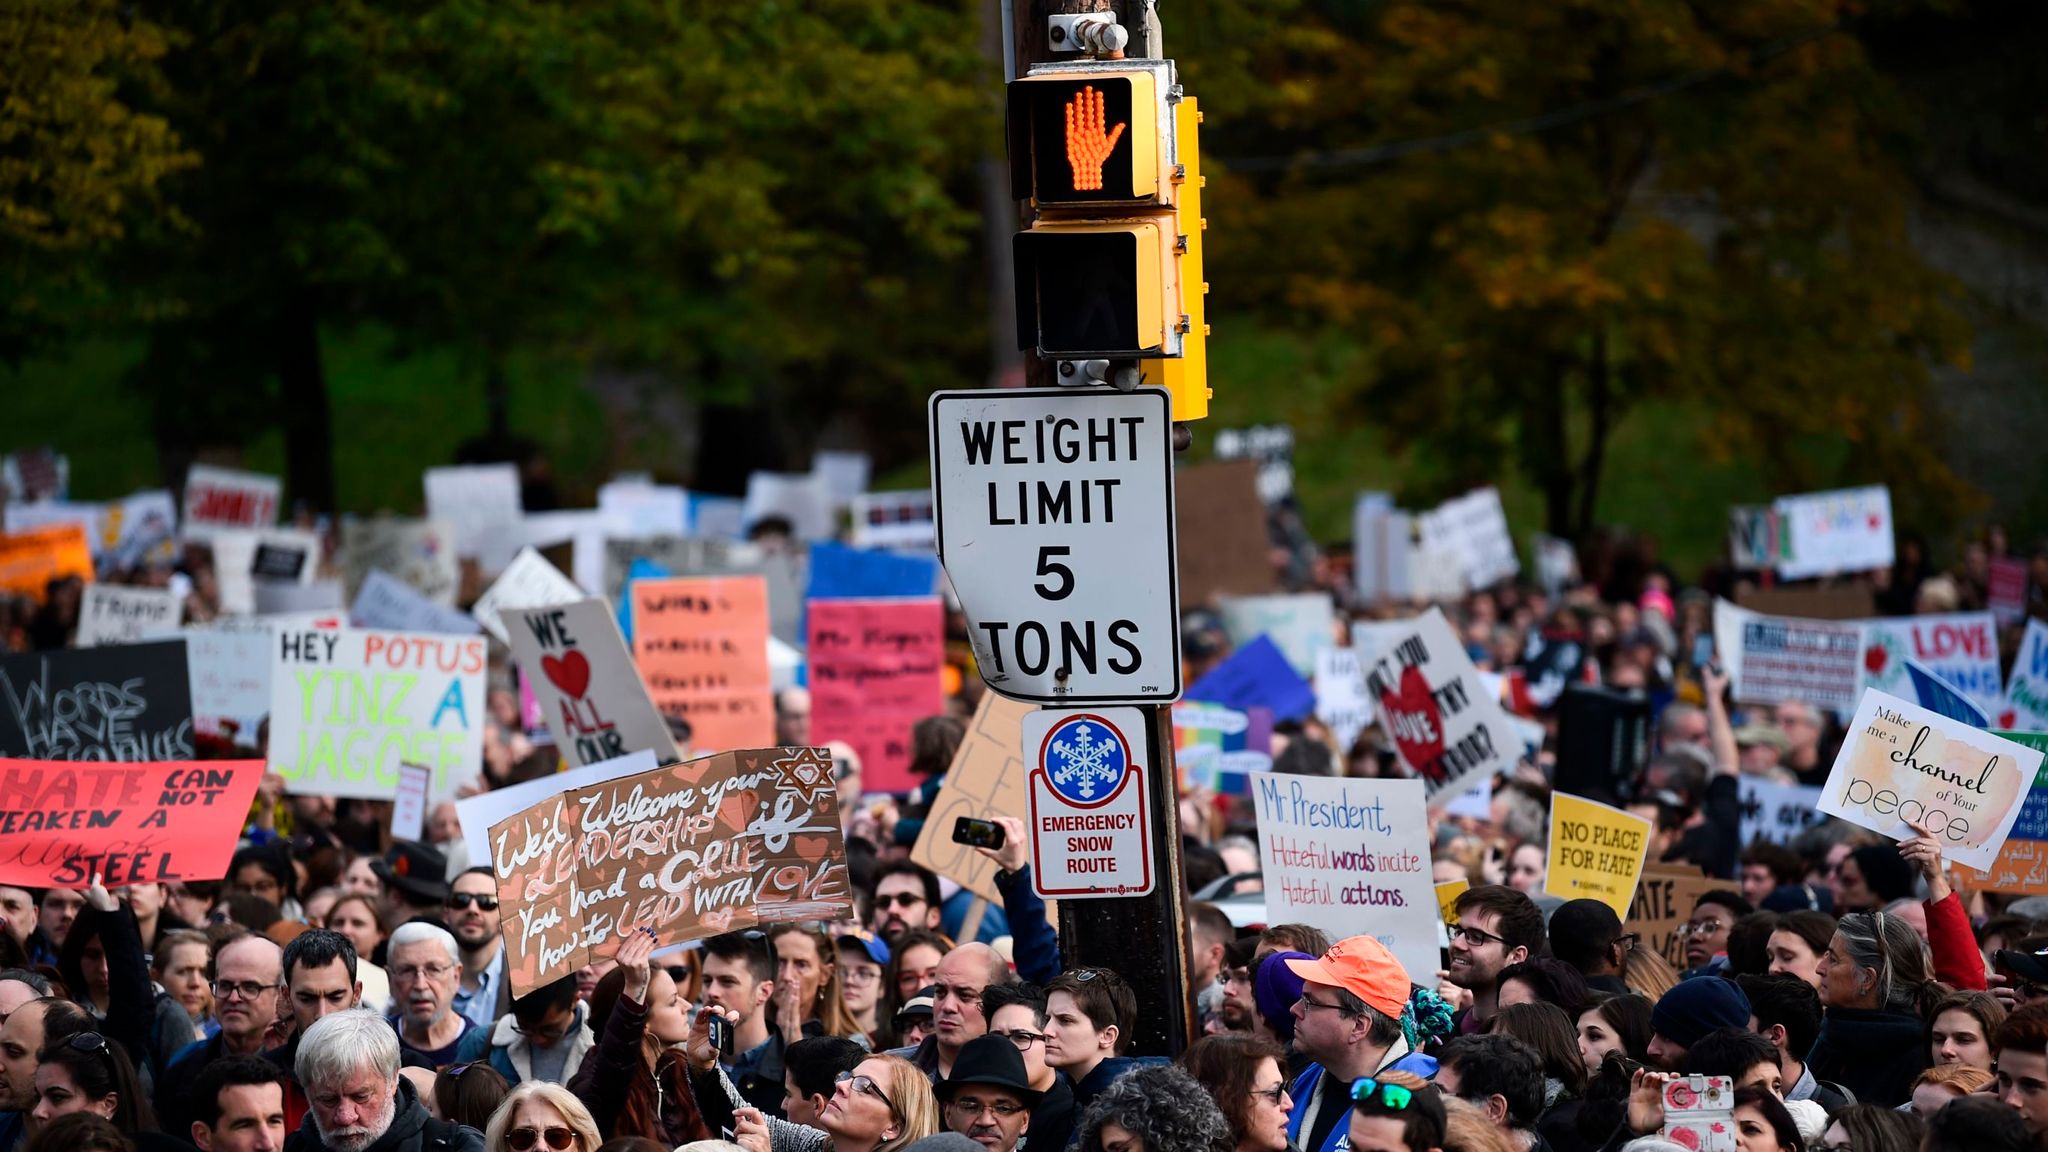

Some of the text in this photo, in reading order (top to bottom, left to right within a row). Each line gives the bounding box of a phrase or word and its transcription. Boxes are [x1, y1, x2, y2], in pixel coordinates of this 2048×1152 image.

[961, 416, 1145, 466] WEIGHT
[988, 478, 1121, 526] LIMIT
[1033, 545, 1075, 601] 5
[524, 610, 578, 650] WE
[979, 619, 1142, 676] TONS
[1912, 623, 1992, 660] LOVE
[281, 632, 484, 675] HEY POTUS
[0, 654, 147, 728] WORDS
[295, 667, 419, 727] YINZ
[430, 676, 469, 730] A
[1053, 685, 1159, 694] R12-1 DPW
[559, 696, 616, 738] ALL
[1866, 724, 1897, 745] me a
[1875, 705, 1911, 729] Make
[275, 728, 469, 794] JAGOFF
[575, 730, 632, 766] OUR
[1890, 725, 1999, 794] channel
[0, 767, 234, 810] HATE CAN
[157, 789, 225, 806] NOT
[578, 783, 700, 834] Welcome
[700, 772, 781, 820] your
[1291, 780, 1392, 836] President,
[1935, 789, 1979, 813] of Your
[138, 809, 168, 829] A
[1042, 814, 1136, 832] EMERGENCY
[1561, 821, 1641, 852] NO PLACE
[524, 791, 838, 901] LEADERSHIP if
[1067, 836, 1113, 853] SNOW
[1067, 857, 1118, 874] ROUTE
[1270, 834, 1422, 873] Hateful words incite
[1560, 847, 1636, 878] FOR HATE
[519, 904, 561, 958] You
[570, 867, 628, 918] had
[638, 872, 657, 889] a
[1280, 876, 1408, 907] Hateful actions.
[1630, 879, 1677, 921] ATE
[538, 858, 849, 976] how to LEAD WITH LOVE
